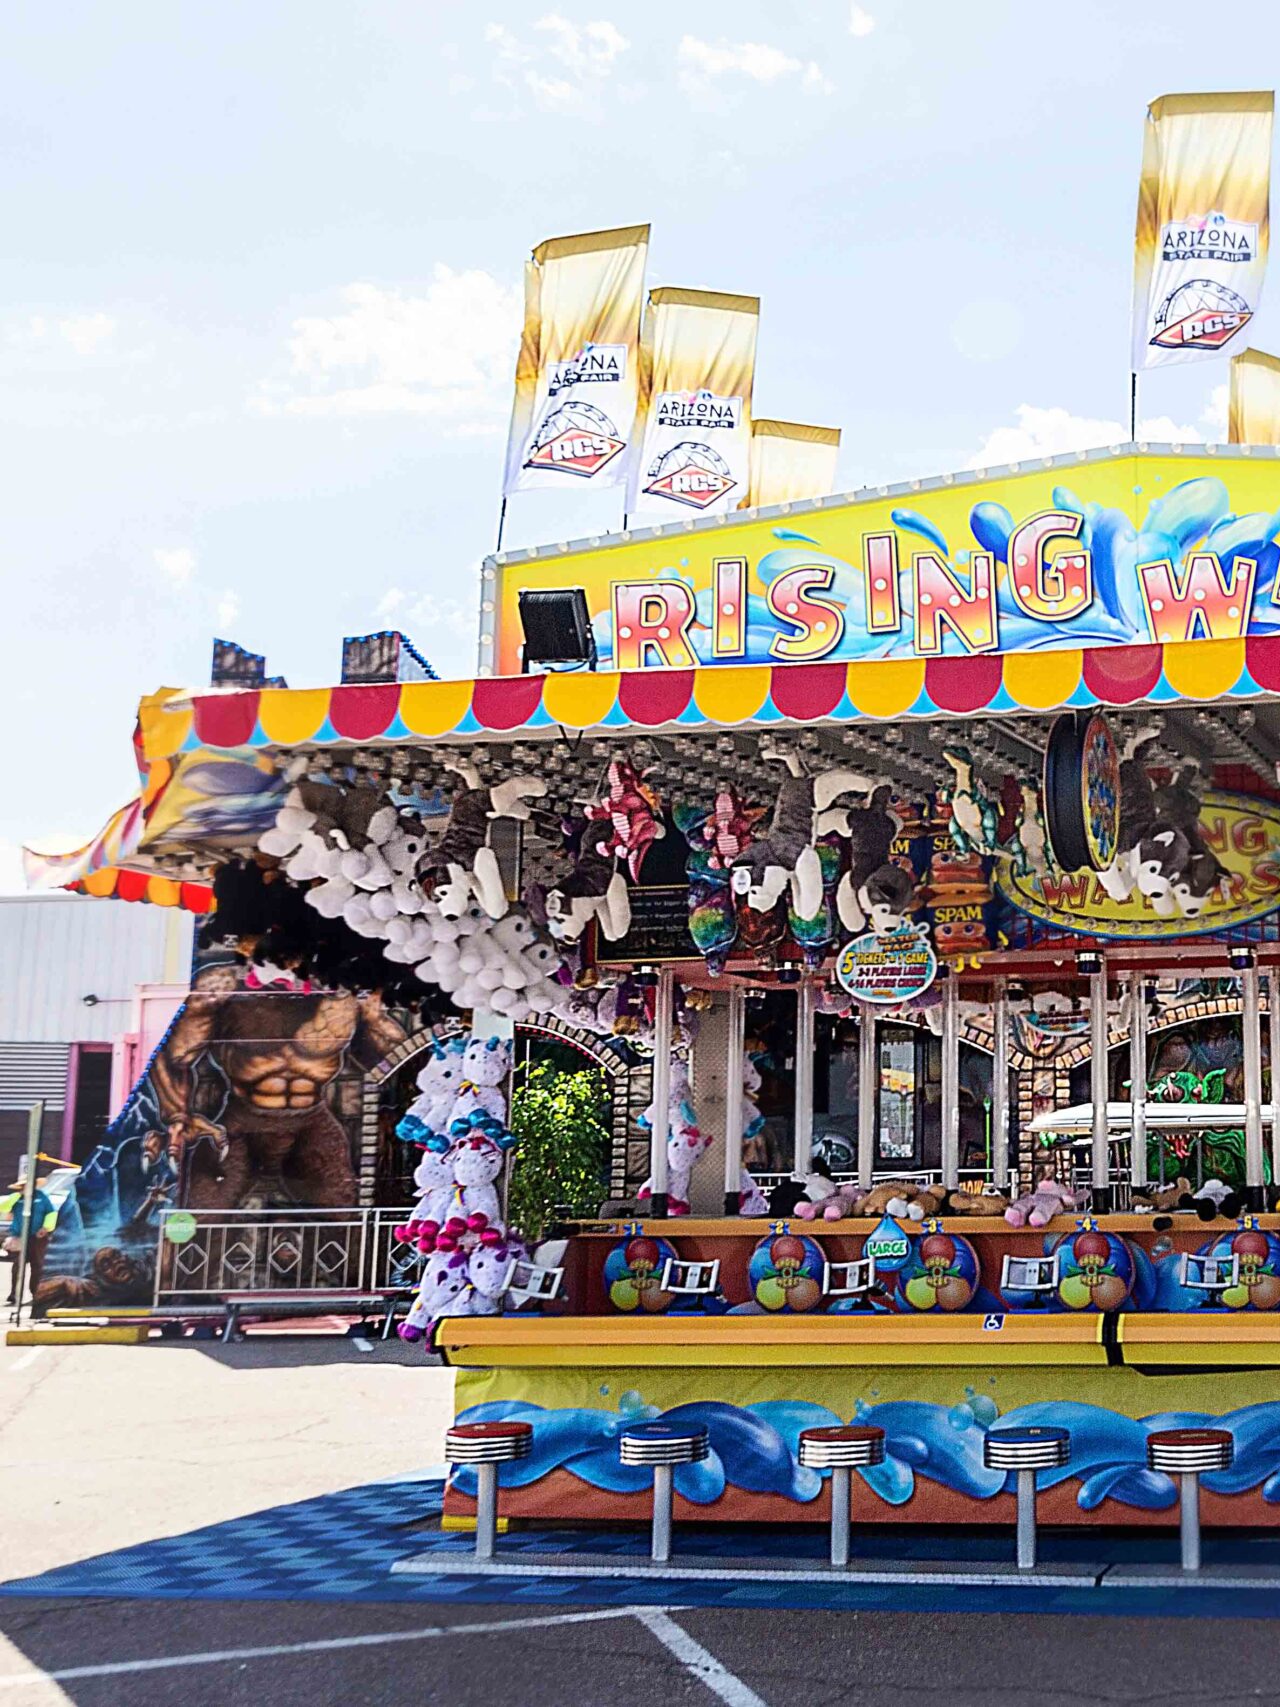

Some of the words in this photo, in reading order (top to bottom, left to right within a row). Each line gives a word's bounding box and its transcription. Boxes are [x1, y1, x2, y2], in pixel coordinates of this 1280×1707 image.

[1163, 229, 1250, 250] ARIZONA
[1168, 250, 1210, 261] STATE
[1213, 251, 1244, 262] FAIR
[1181, 313, 1241, 342] RCS
[658, 402, 735, 419] ARIZONA
[663, 418, 698, 427] STATE
[700, 419, 729, 428] FAIR
[549, 436, 612, 462] RCS
[671, 474, 725, 493] RCS
[610, 507, 1093, 668] RISING
[934, 905, 983, 923] SPAM
[841, 952, 856, 975] 5
[856, 953, 887, 965] TICKETS
[905, 953, 929, 965] GAME
[775, 1221, 785, 1234] 2
[929, 1219, 937, 1233] 3
[1082, 1217, 1092, 1231] 4
[1243, 1215, 1253, 1229] 5
[869, 1240, 906, 1256] LARGE
